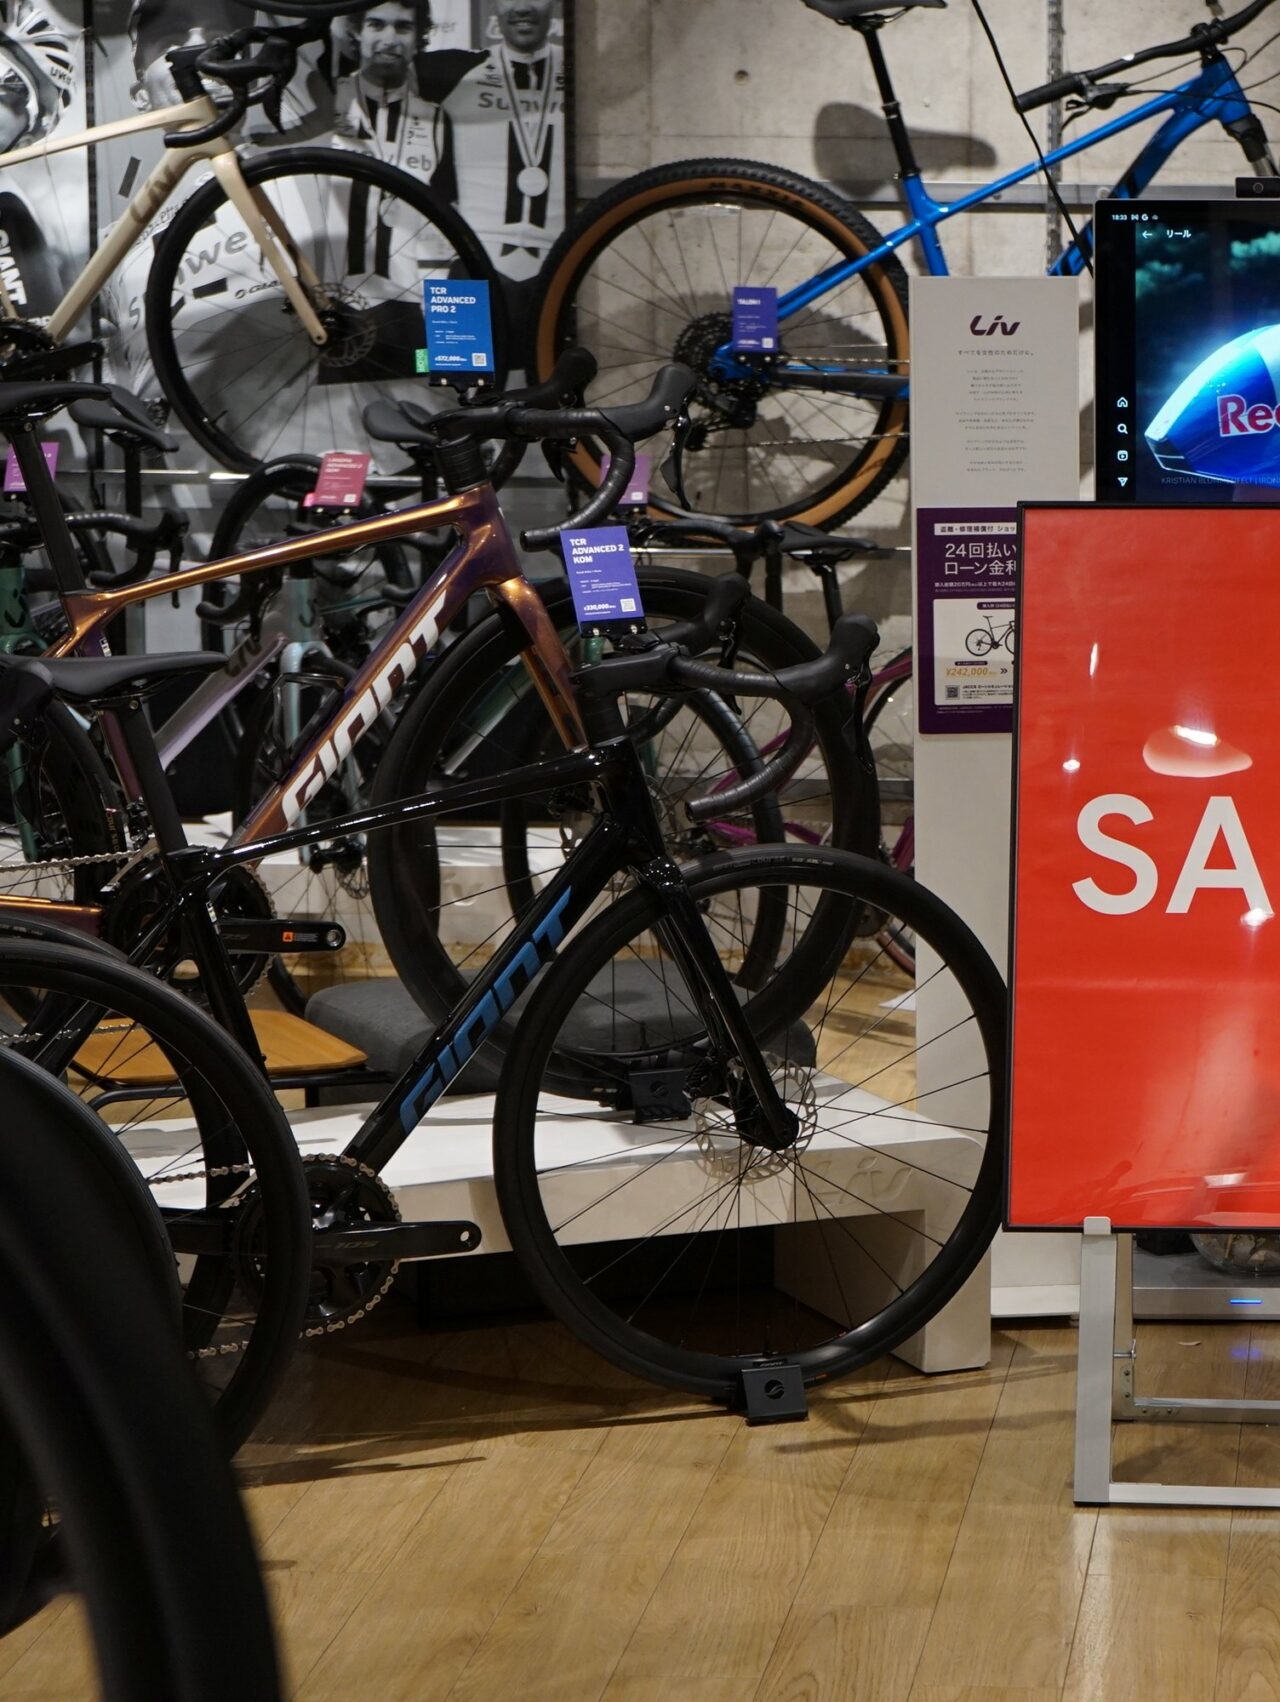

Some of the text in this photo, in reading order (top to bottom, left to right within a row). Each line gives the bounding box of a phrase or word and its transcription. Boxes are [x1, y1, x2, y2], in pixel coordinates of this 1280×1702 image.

[1166, 229, 1192, 238] リール
[430, 286, 447, 295] TCR
[430, 296, 476, 305] ADVANCED
[431, 305, 456, 313] PRO 2
[969, 315, 1021, 336] Liv
[569, 538, 587, 546] TCR
[572, 544, 625, 555] ADVANCED 2
[573, 556, 593, 564] KOM
[282, 588, 448, 830] GIANT
[399, 885, 572, 1137] GIANT
